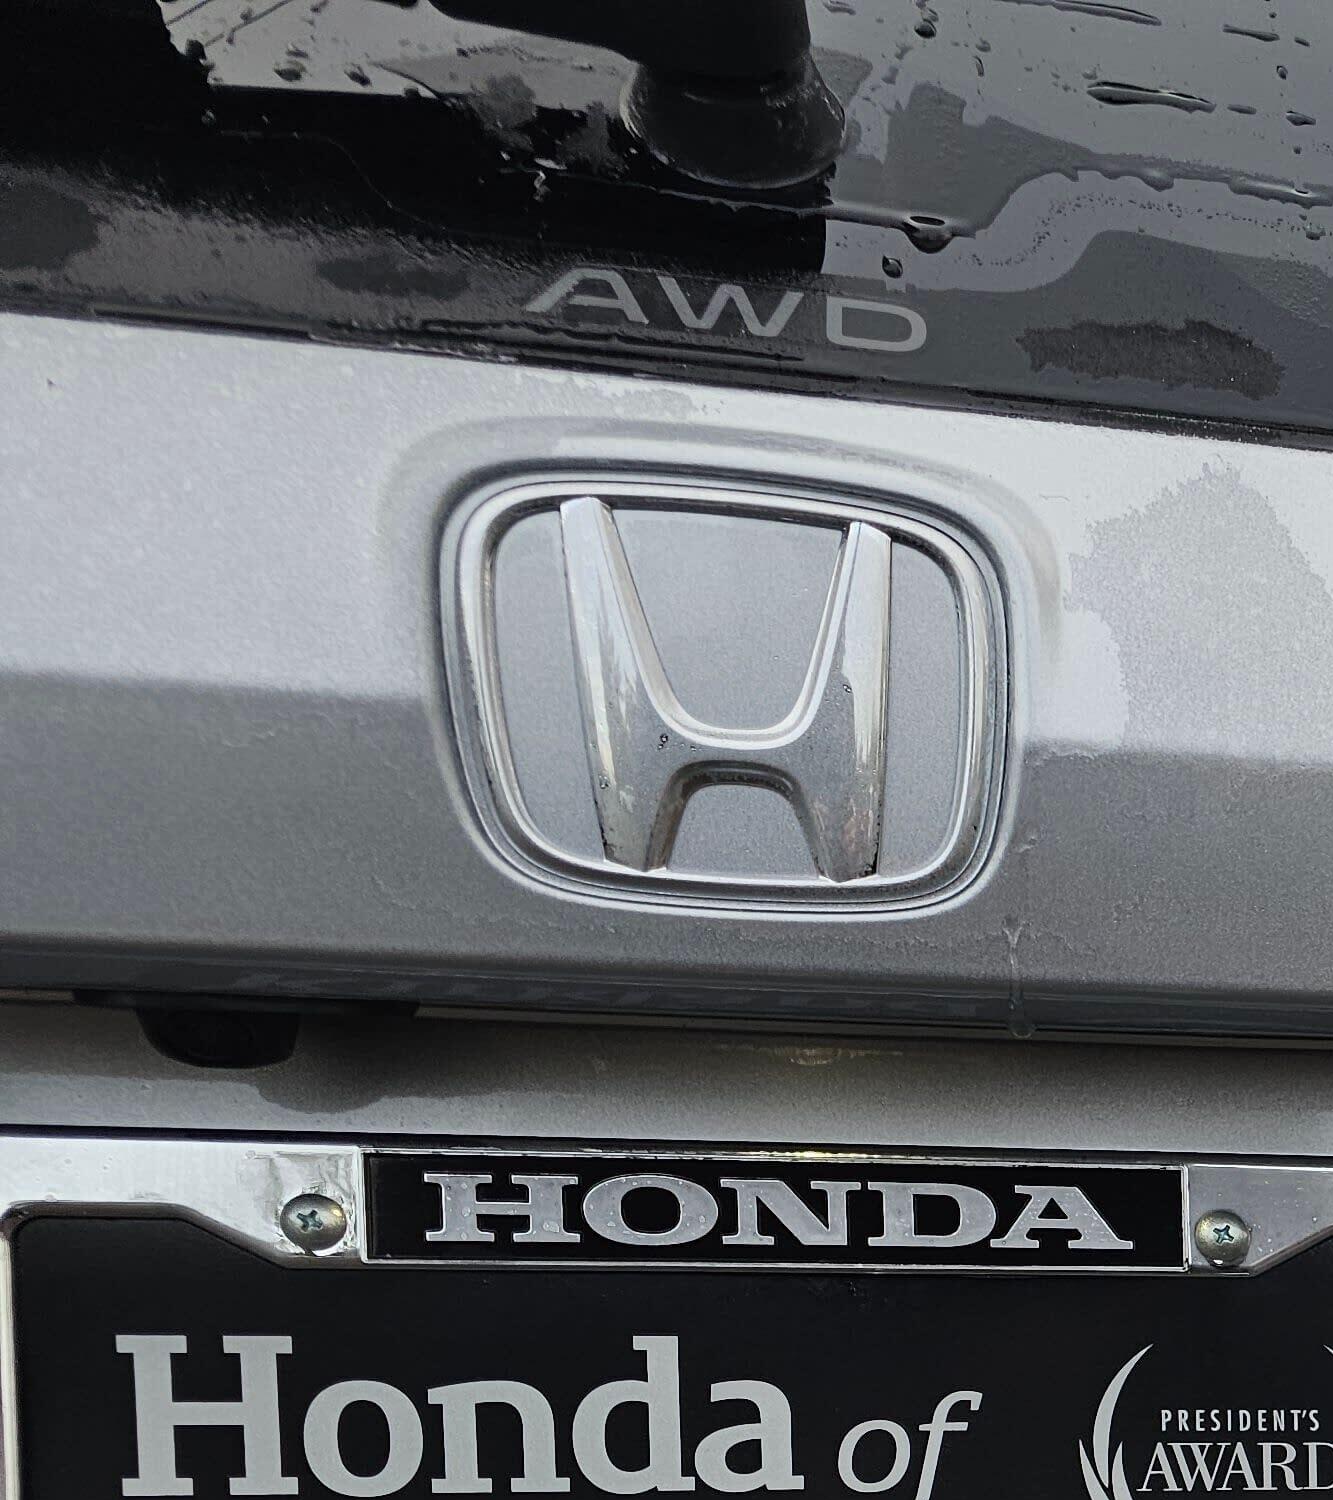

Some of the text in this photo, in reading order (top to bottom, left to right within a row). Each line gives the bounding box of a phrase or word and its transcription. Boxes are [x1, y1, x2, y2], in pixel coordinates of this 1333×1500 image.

[526, 268, 930, 352] AWD
[422, 1171, 1133, 1251] HONDA
[115, 1334, 805, 1497] Honda
[1160, 1408, 1322, 1433] PRESIDENT'S
